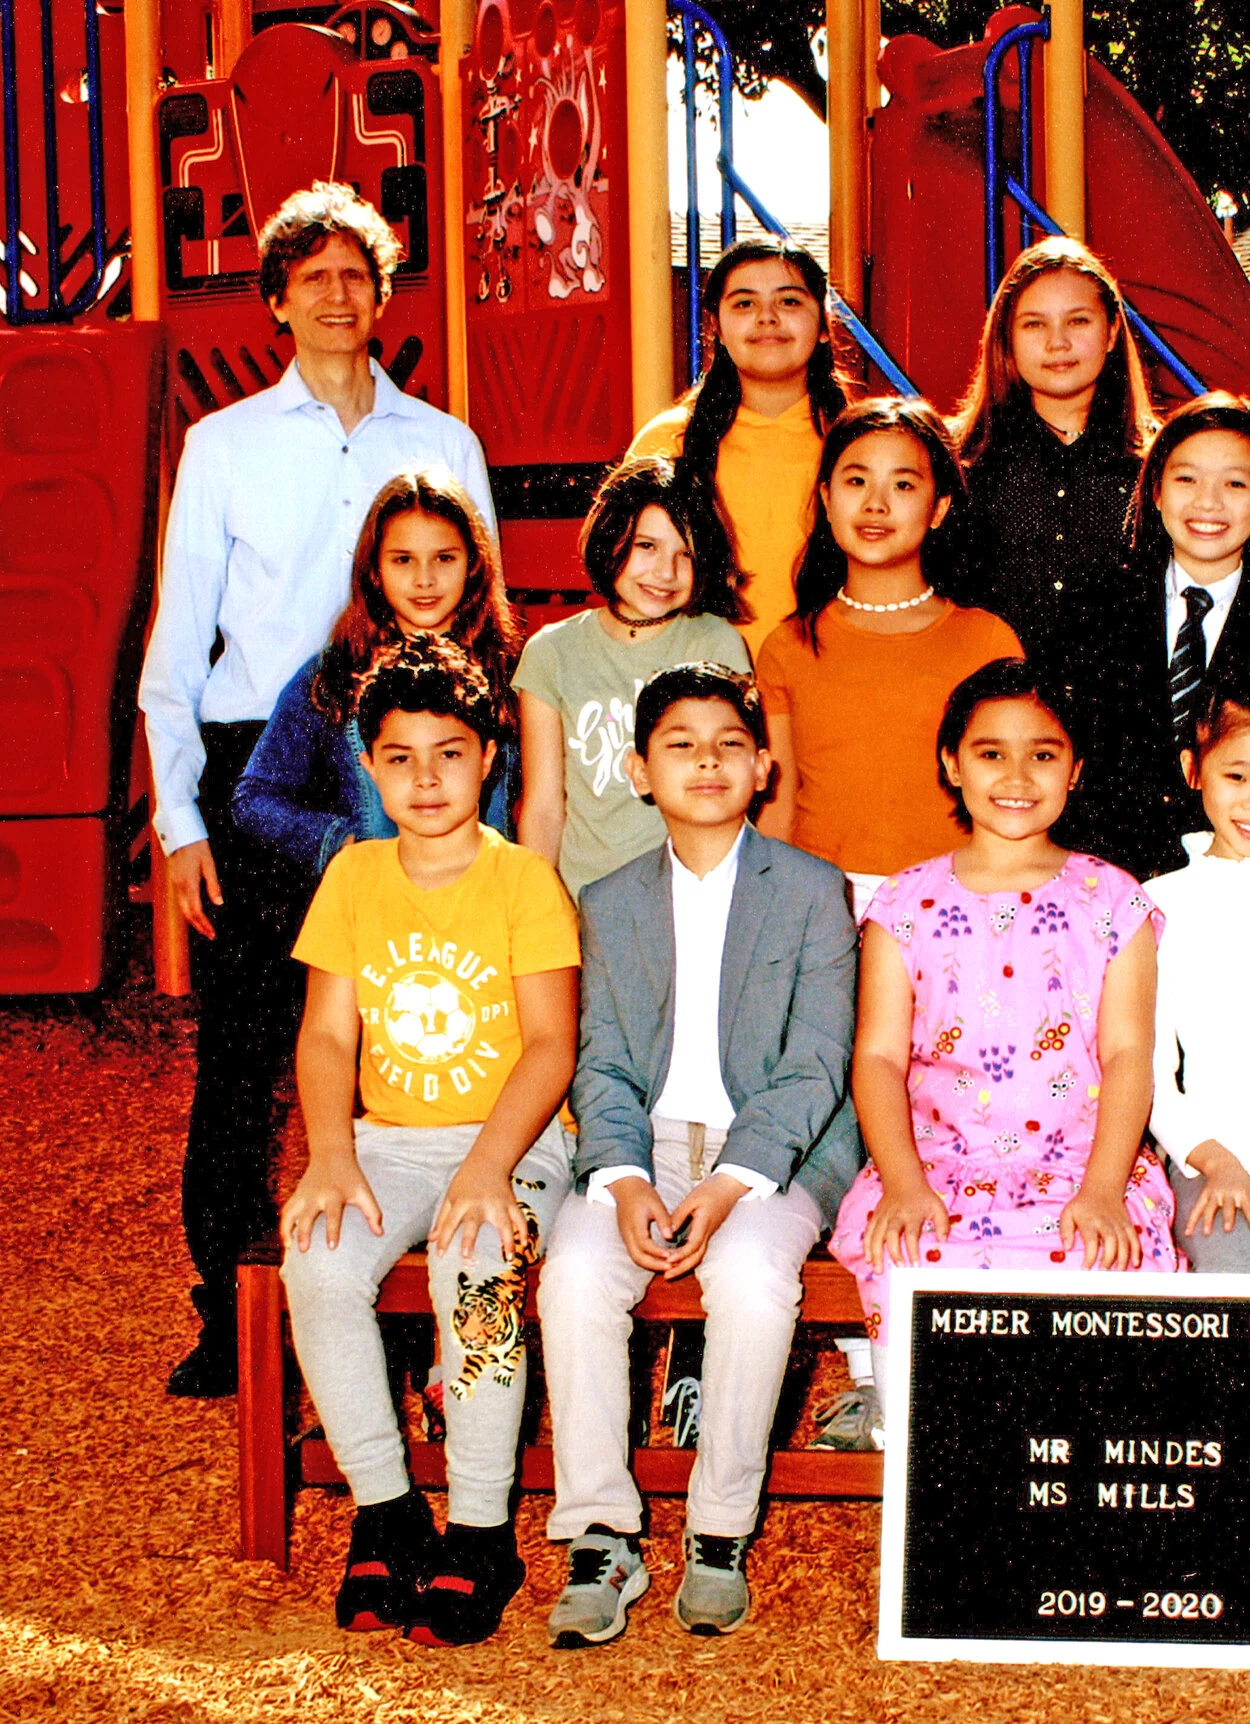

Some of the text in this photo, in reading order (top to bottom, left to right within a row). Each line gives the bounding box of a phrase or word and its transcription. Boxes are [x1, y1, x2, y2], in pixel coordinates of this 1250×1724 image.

[370, 1043, 439, 1102] FIELD
[449, 1040, 500, 1095] DIV
[931, 1308, 1031, 1335] MEHER
[1051, 1311, 1229, 1338] MONTESSORI
[1029, 1437, 1222, 1467] MR MINDES
[1029, 1481, 1195, 1509] MS MILLS
[1037, 1589, 1106, 1616] 2019
[1143, 1592, 1223, 1619] 2020
